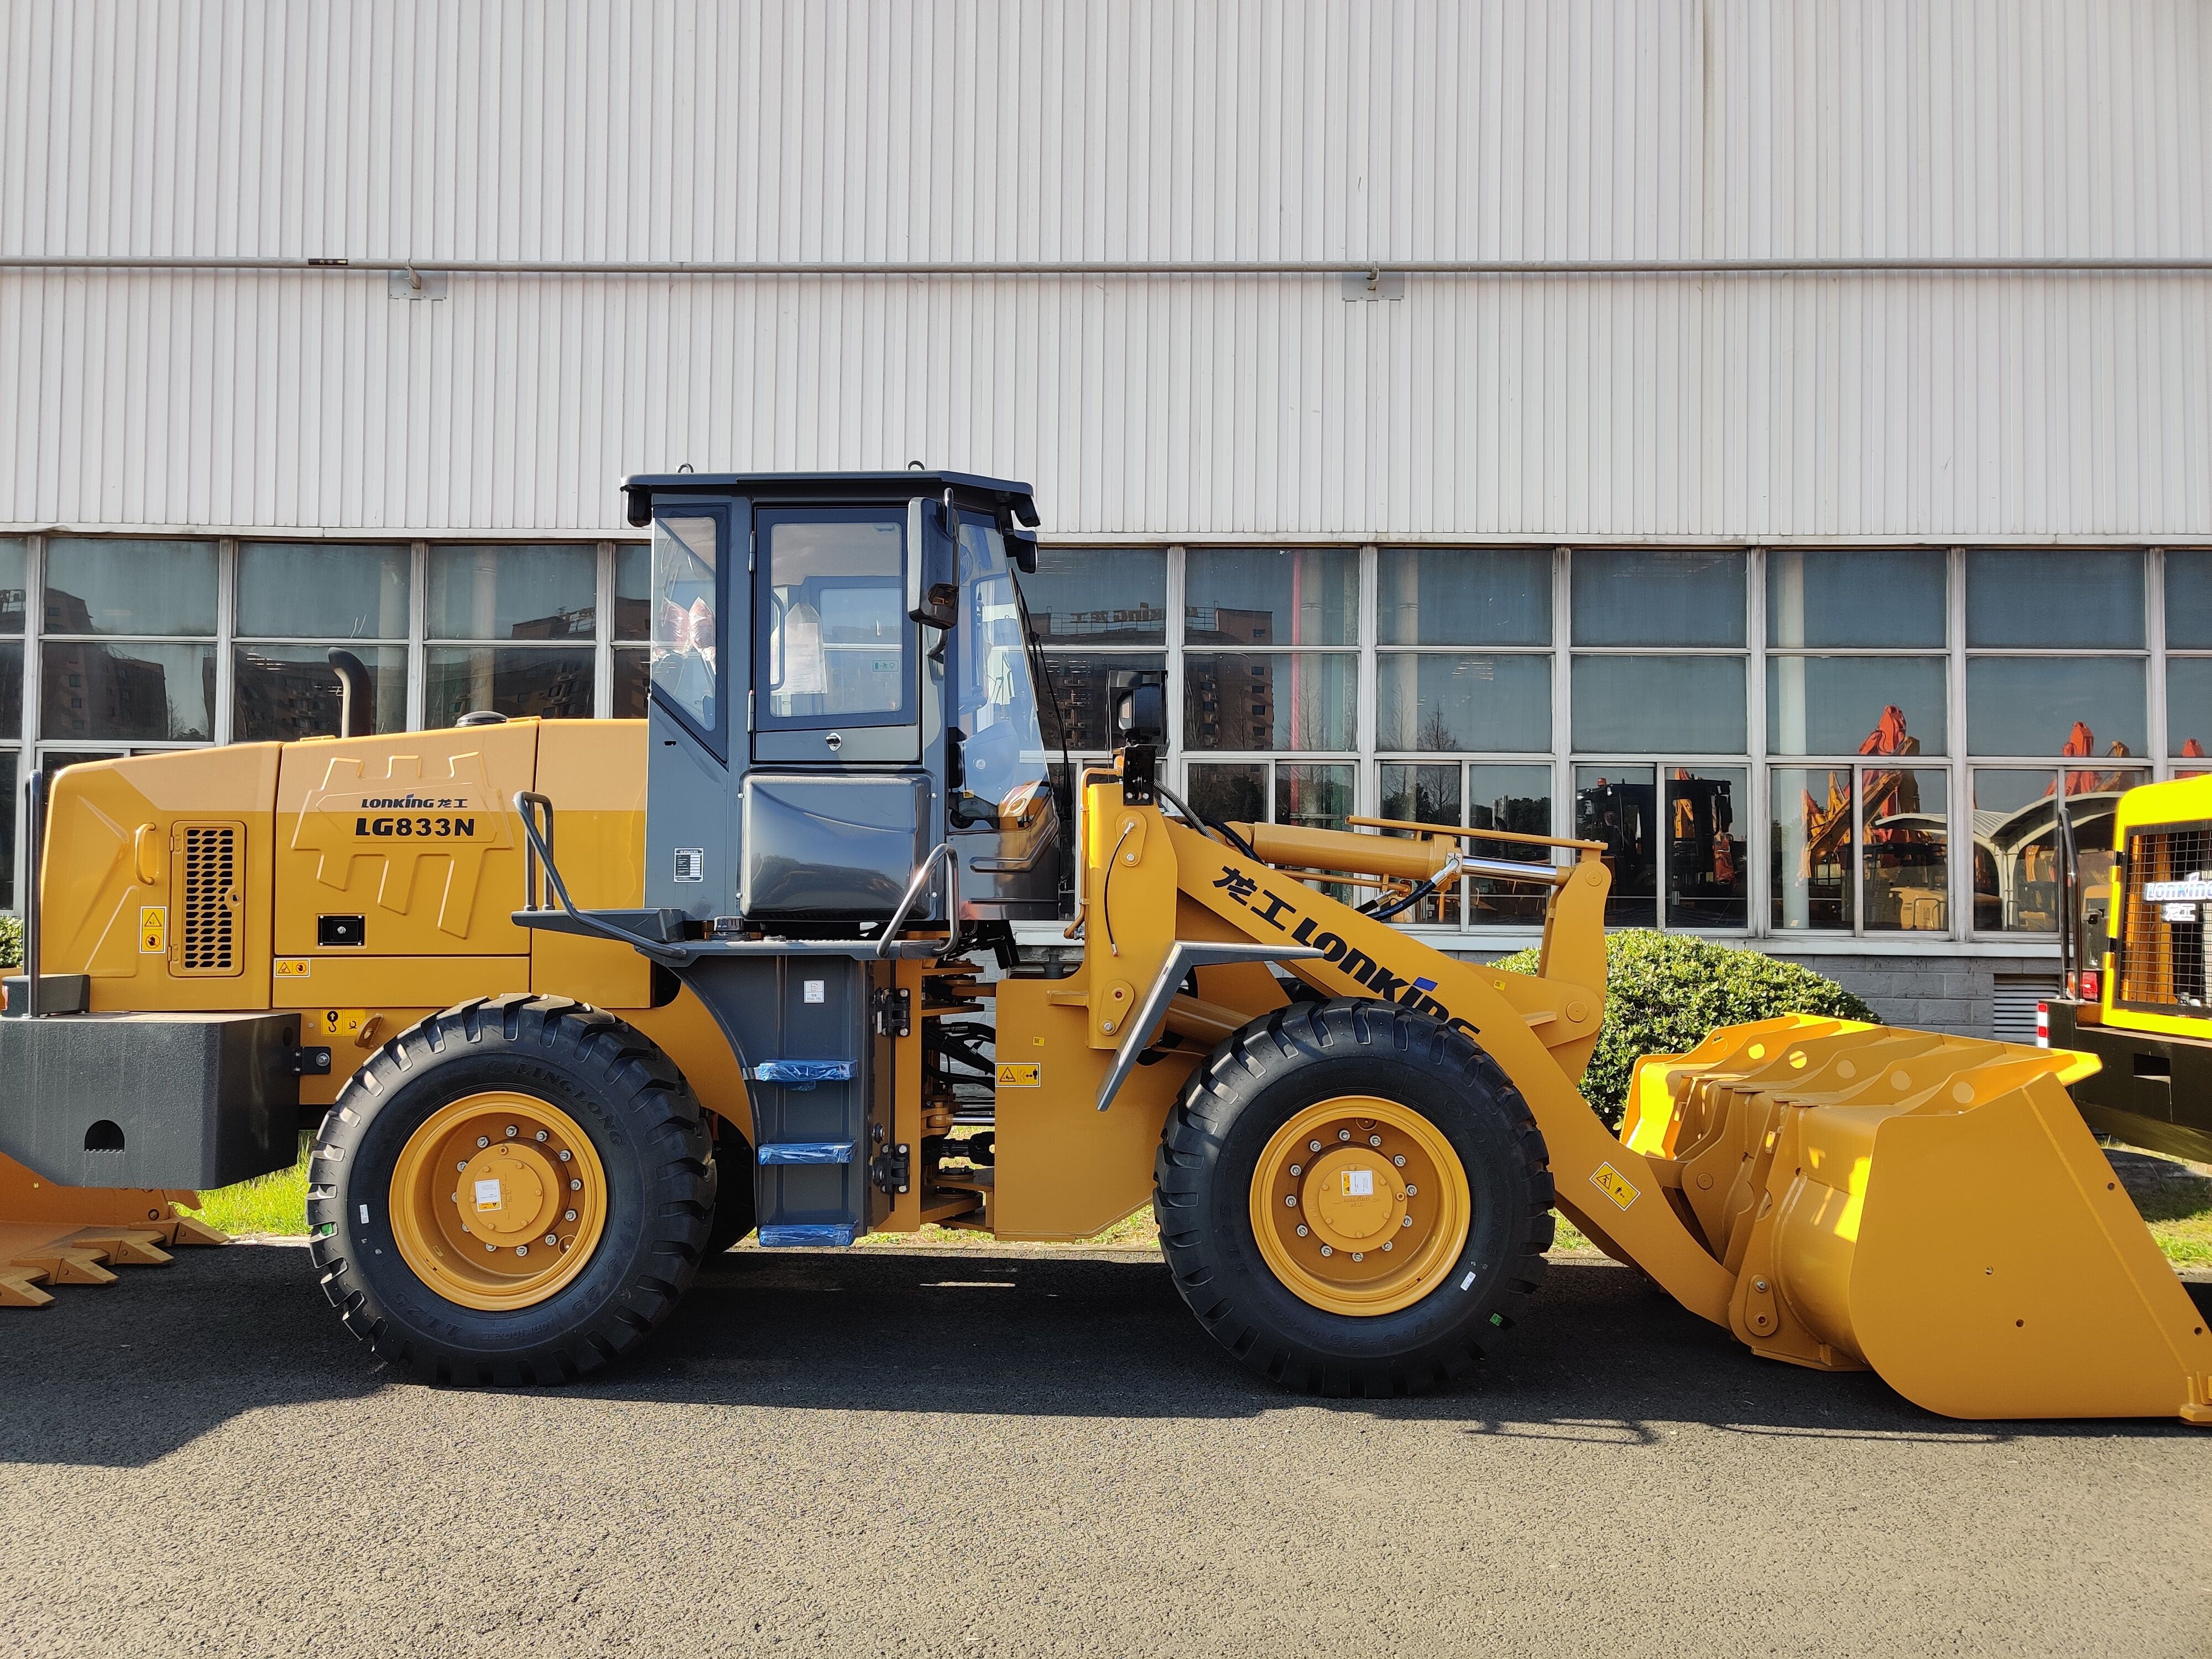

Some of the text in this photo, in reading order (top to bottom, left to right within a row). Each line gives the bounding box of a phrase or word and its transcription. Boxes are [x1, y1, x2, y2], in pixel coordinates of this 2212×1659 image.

[437, 799, 468, 808] 龙工
[355, 817, 475, 837] LG833N
[1212, 865, 1297, 931] 龙工
[514, 1062, 625, 1146] LINGLONG
